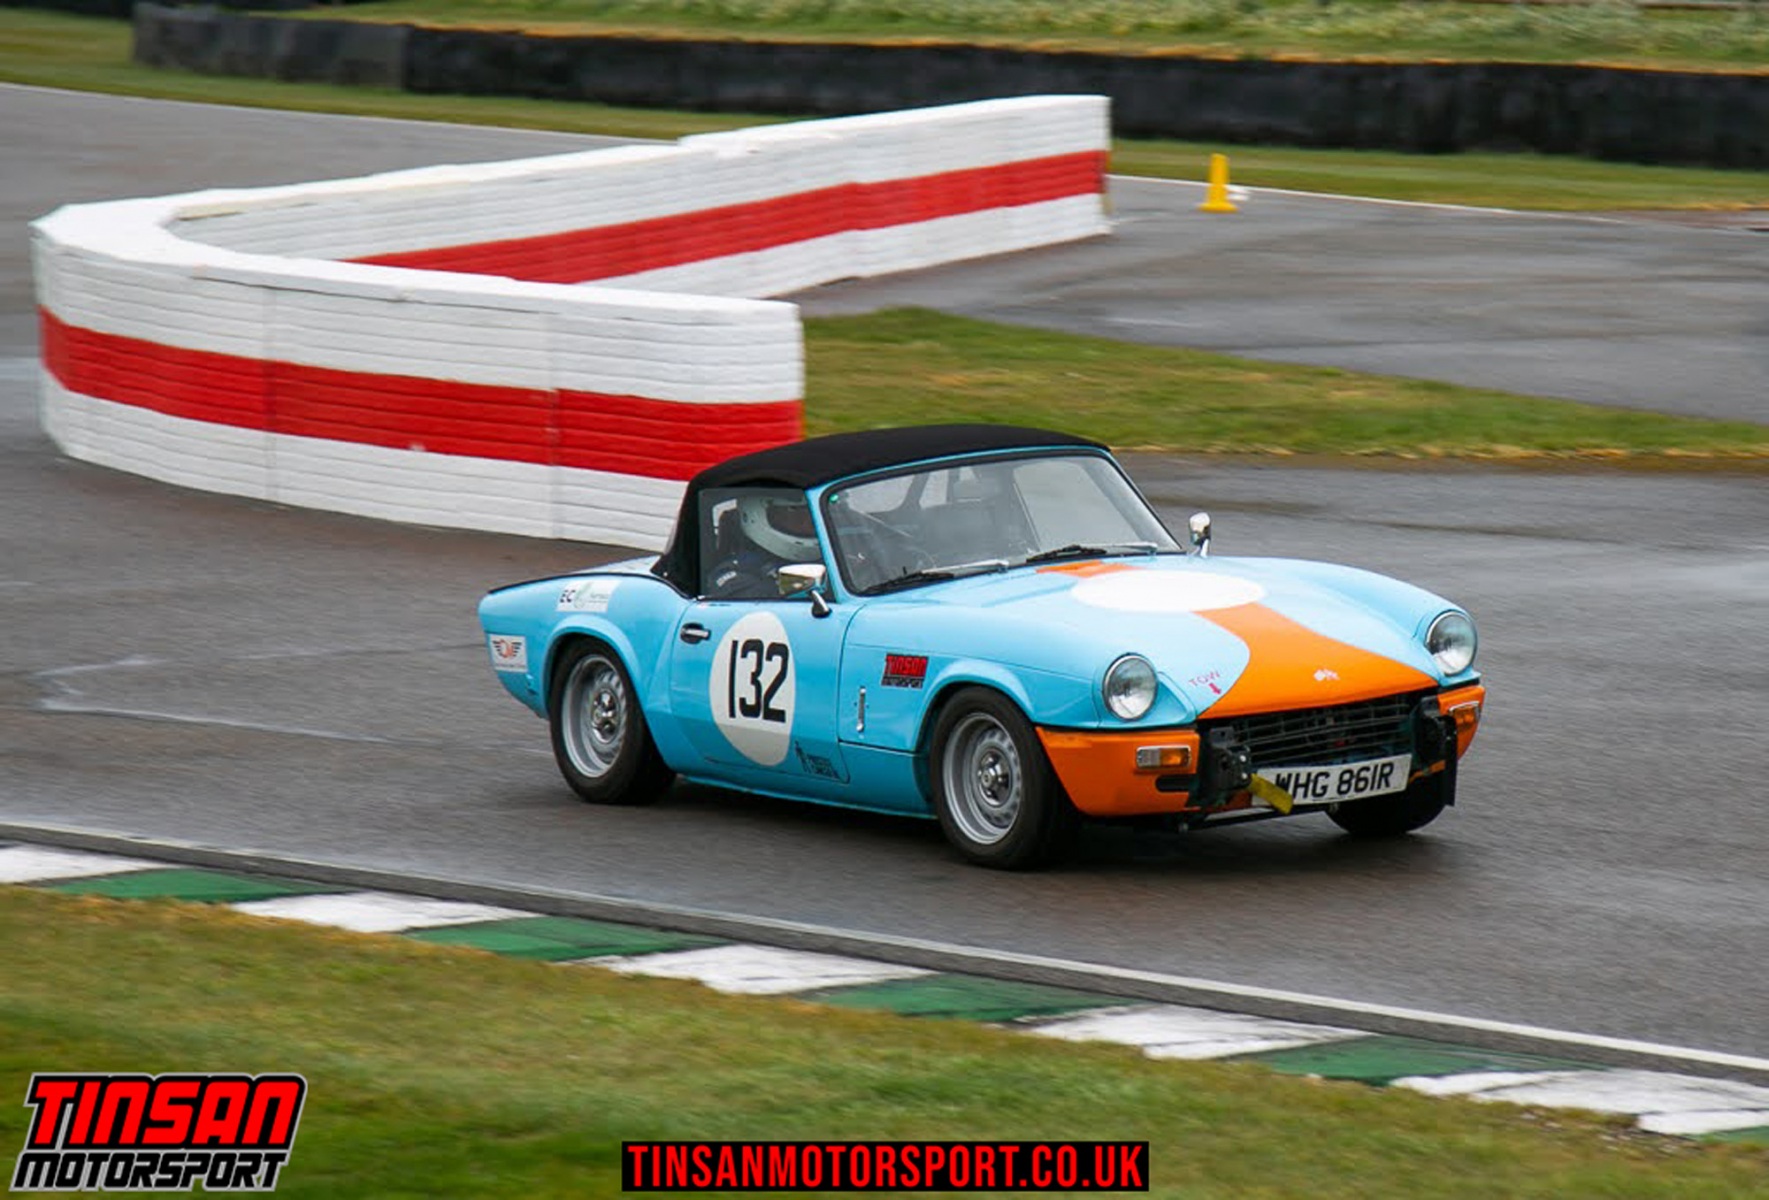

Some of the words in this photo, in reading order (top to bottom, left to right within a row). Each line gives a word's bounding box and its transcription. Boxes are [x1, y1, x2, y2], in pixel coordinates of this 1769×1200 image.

[729, 639, 789, 723] 132
[1275, 771, 1330, 799] WHG
[1336, 762, 1394, 795] 861R
